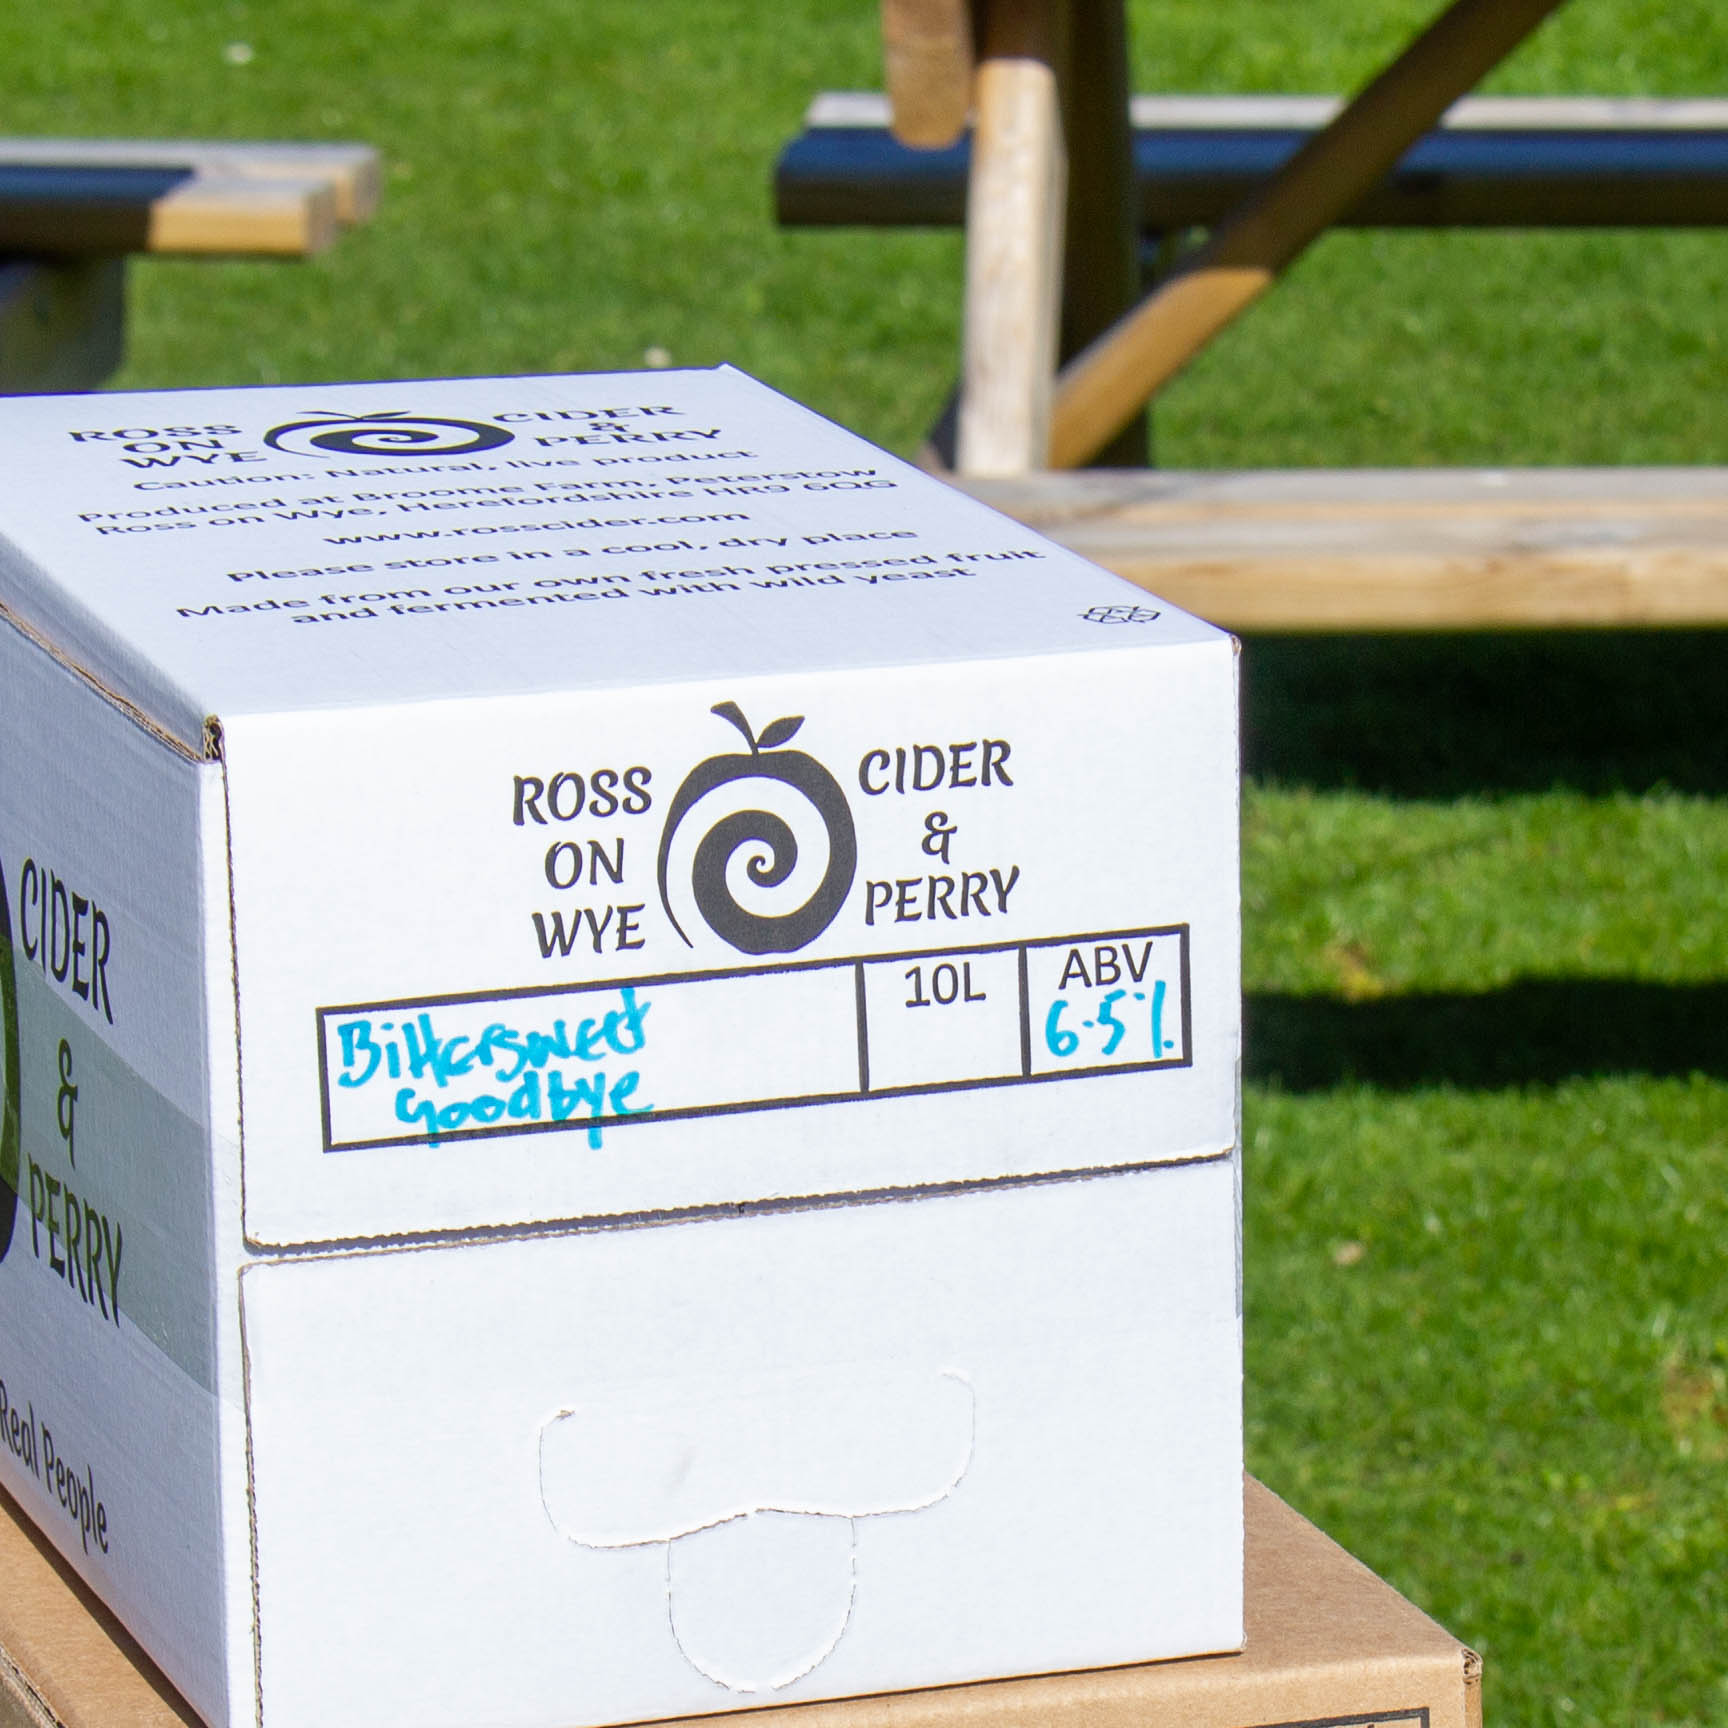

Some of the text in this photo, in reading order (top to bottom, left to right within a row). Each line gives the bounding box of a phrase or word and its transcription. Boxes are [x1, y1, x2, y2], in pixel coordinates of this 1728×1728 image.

[69, 424, 242, 442] ROSS
[492, 405, 687, 422] CIDER
[534, 428, 721, 447] PERRY
[588, 421, 631, 432] &
[121, 450, 267, 468] WYE
[123, 438, 224, 453] ON
[133, 471, 315, 491] Caution:
[507, 456, 580, 468] live
[593, 450, 759, 466] product
[78, 498, 286, 523] Produced
[298, 495, 344, 506] at
[353, 484, 523, 502] Broome
[666, 469, 877, 485] Peterstow
[96, 521, 196, 535] Ross
[209, 515, 265, 526] on
[273, 508, 387, 520] Wye,
[396, 490, 693, 513] Herefordshire
[703, 483, 791, 496] HR9
[322, 511, 750, 545] www.rosscider.com
[175, 547, 1047, 618] Made from our own fresh pressed fruit
[226, 529, 919, 583] Please store in a cool, dry place
[291, 566, 977, 624] and fermented with wild yeast
[858, 738, 1014, 796] CIDER
[511, 766, 653, 827] ROSS
[543, 837, 625, 891] ON
[922, 810, 958, 864] &
[864, 866, 1021, 926] PERRY
[20, 858, 115, 1026] CIDER
[531, 904, 646, 960] WYE
[905, 962, 987, 1008] 10L
[1058, 941, 1153, 990] ABV
[57, 1037, 80, 1171] &
[27, 1151, 124, 1328] PERRY
[41, 1420, 109, 1555] People
